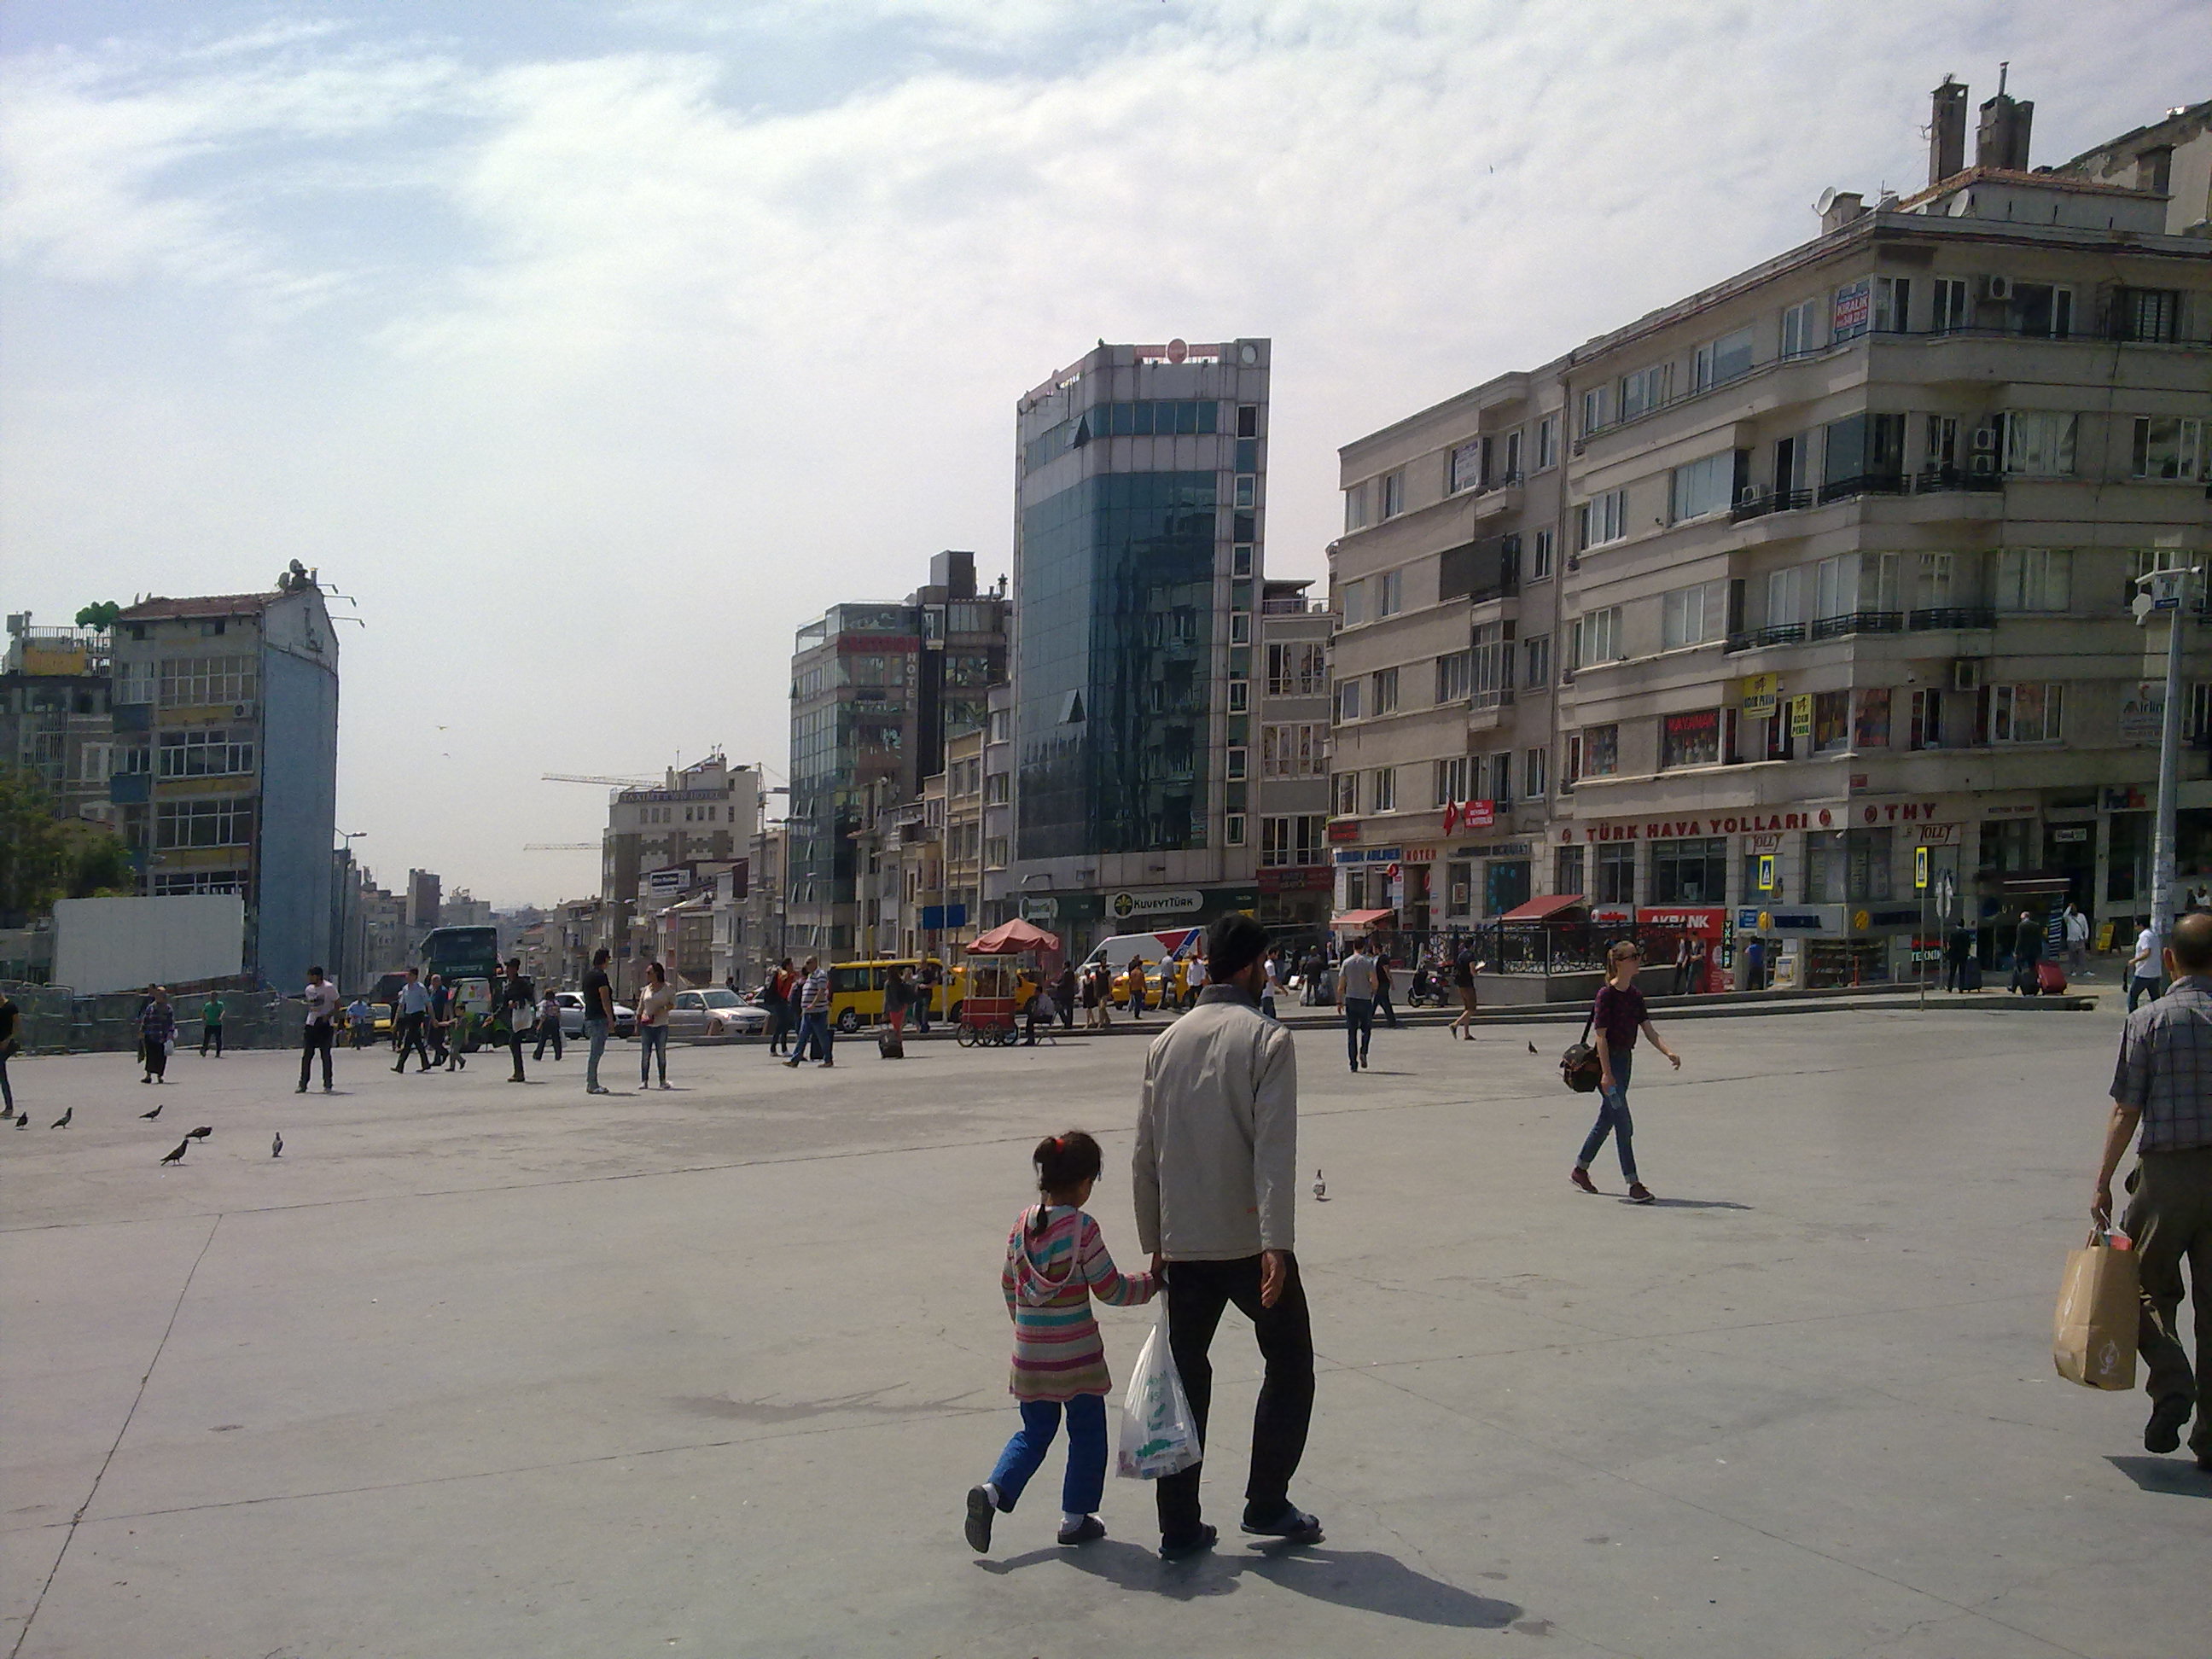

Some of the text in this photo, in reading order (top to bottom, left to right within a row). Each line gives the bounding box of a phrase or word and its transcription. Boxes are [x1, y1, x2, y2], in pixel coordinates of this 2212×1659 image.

[905, 652, 916, 710] HOTEL
[2123, 701, 2163, 713] Airlin
[1884, 803, 1936, 819] THY
[1586, 813, 1807, 842] TÜRK HAVA YOLLARI
[1651, 915, 1710, 928] AKBANK
